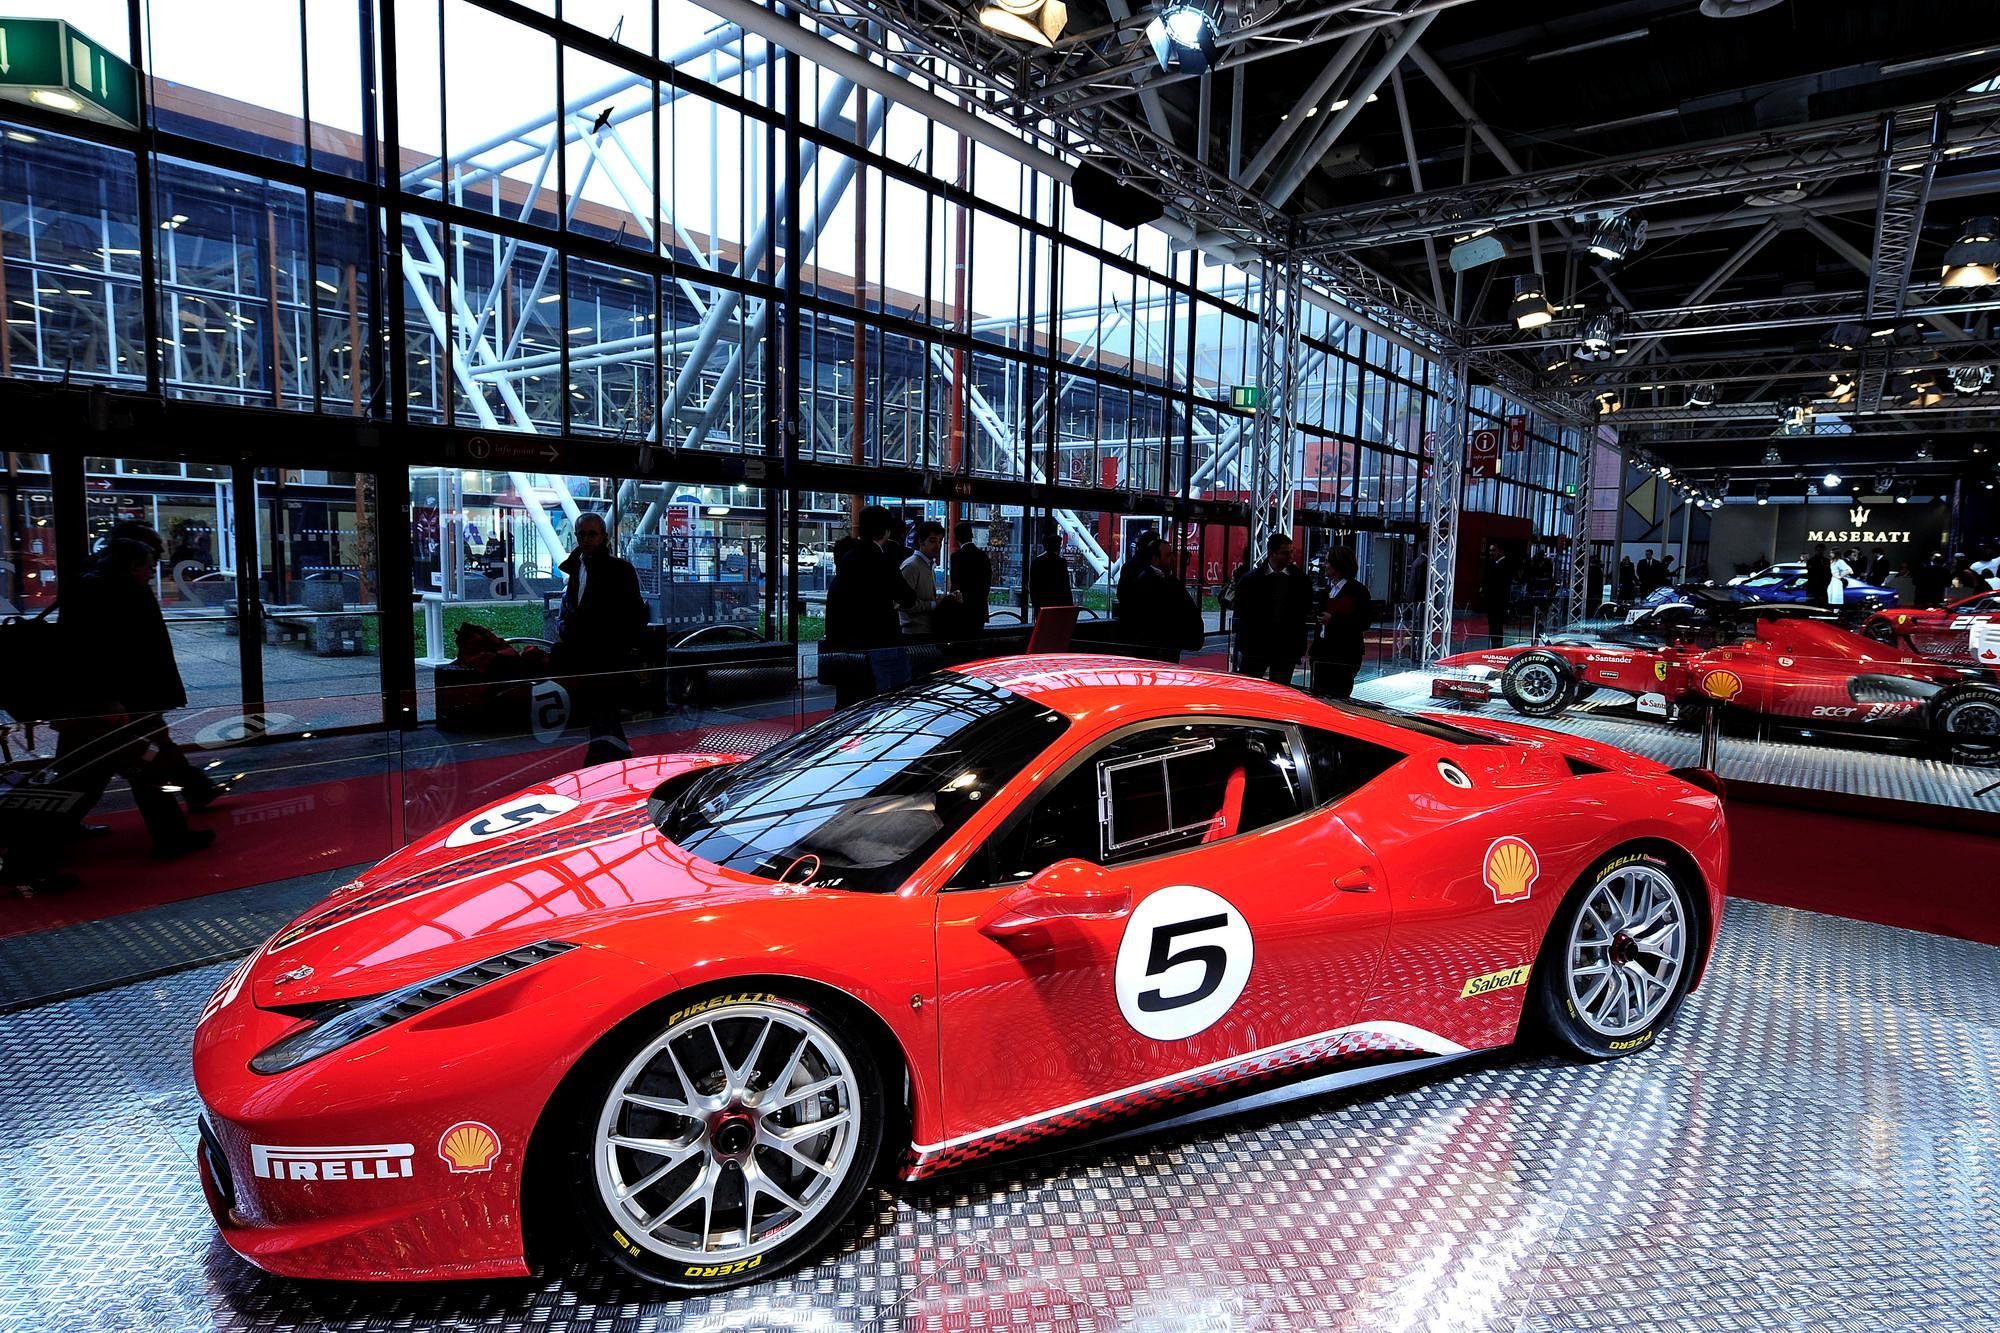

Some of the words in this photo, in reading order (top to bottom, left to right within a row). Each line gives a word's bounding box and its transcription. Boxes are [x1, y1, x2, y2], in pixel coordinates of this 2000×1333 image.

[1807, 531, 1911, 543] MASERATI
[1595, 654, 1632, 664] Santander
[1812, 705, 1857, 717] acer
[470, 802, 562, 836] 5
[1596, 853, 1642, 883] PIRELLI
[1137, 912, 1229, 1013] 5
[1468, 968, 1522, 994] Sabelt
[668, 992, 763, 1026] PIRELLI
[250, 1143, 415, 1181] PIRELLI
